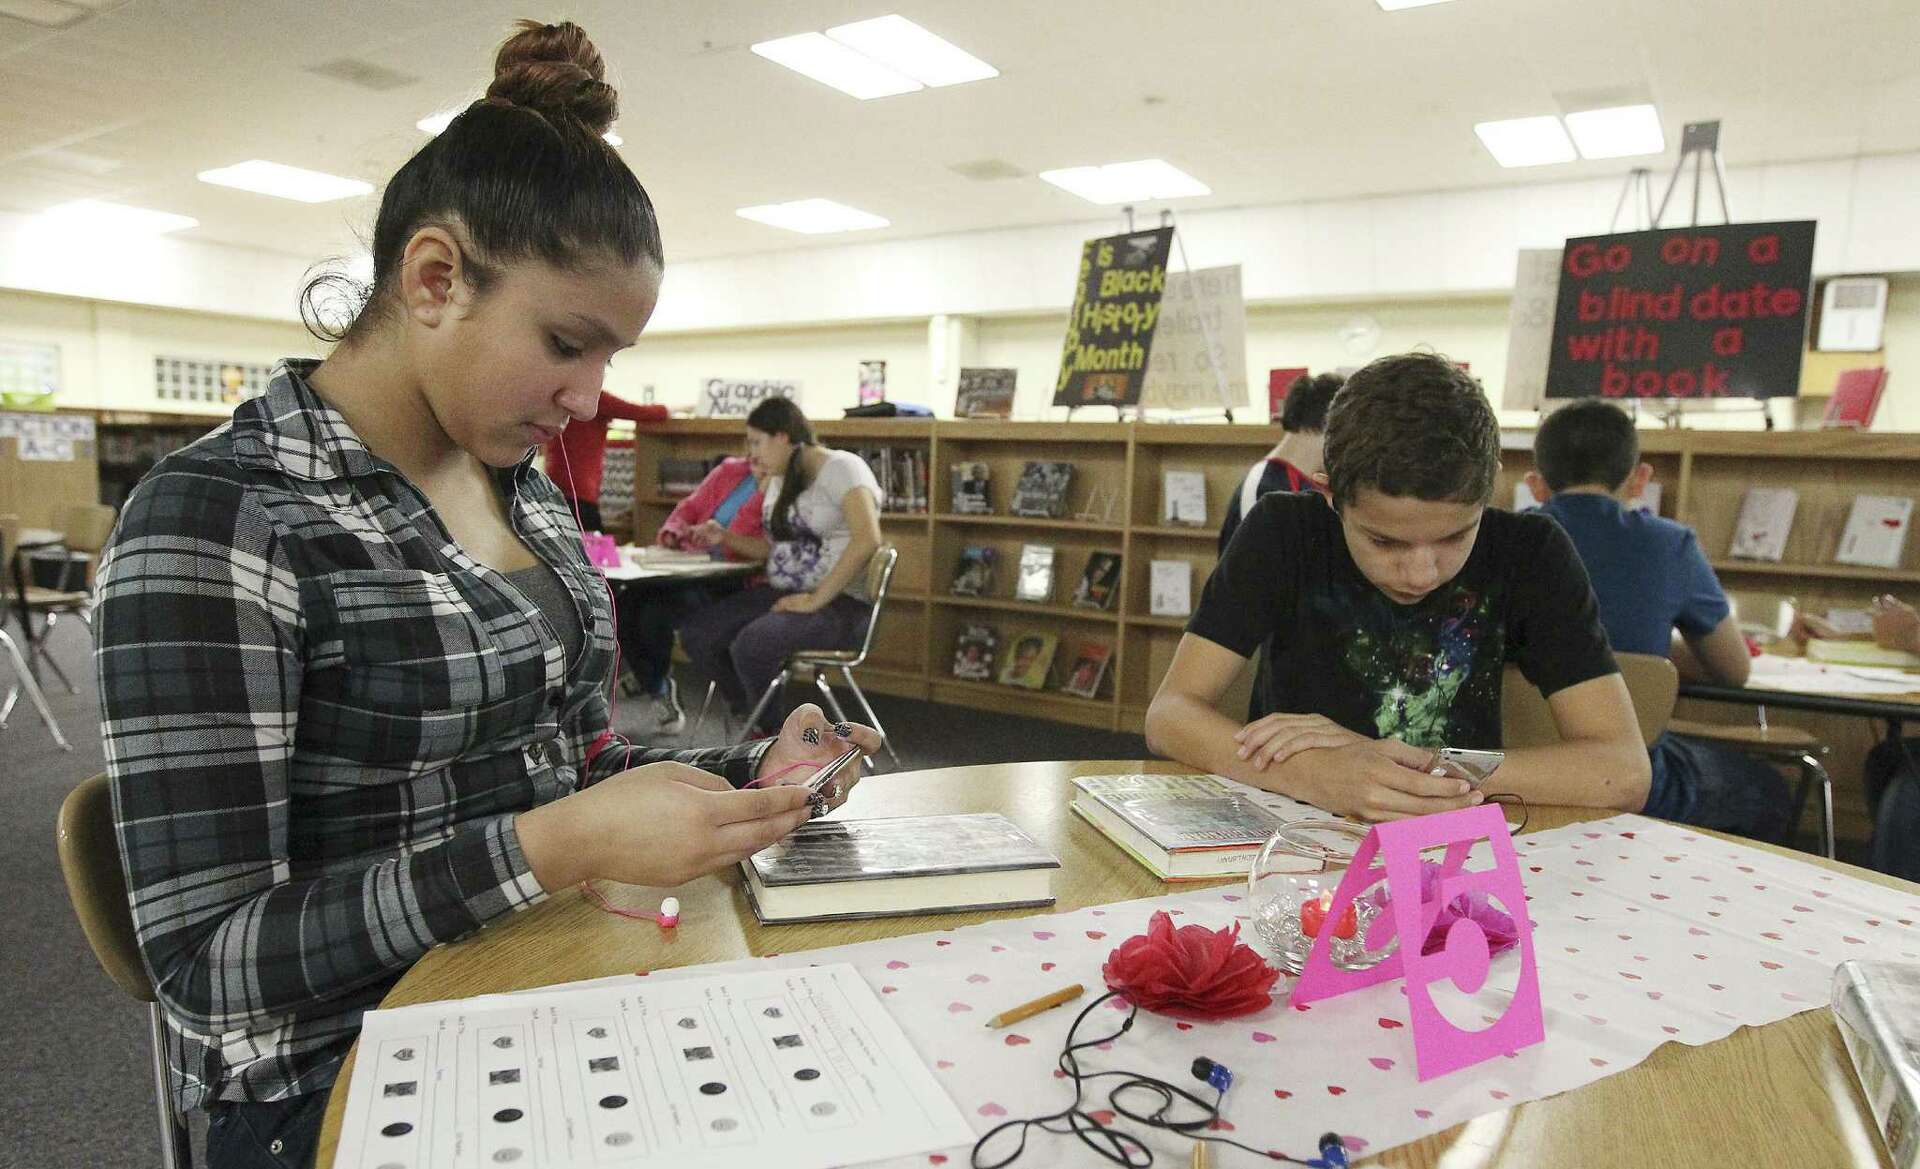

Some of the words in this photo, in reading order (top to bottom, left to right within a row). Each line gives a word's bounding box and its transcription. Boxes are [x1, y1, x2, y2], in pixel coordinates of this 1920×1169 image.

[1567, 243, 1633, 278] Go
[1661, 236, 1720, 265] on
[1747, 234, 1781, 264] a
[1100, 264, 1166, 298] Black
[1578, 286, 1684, 321] blind
[1690, 281, 1801, 319] date
[1074, 341, 1145, 371] Month
[1568, 326, 1659, 361] with
[1712, 326, 1744, 356] a
[707, 378, 795, 402] Graphic
[1602, 363, 1735, 398] book
[1418, 835, 1523, 1033] 5
